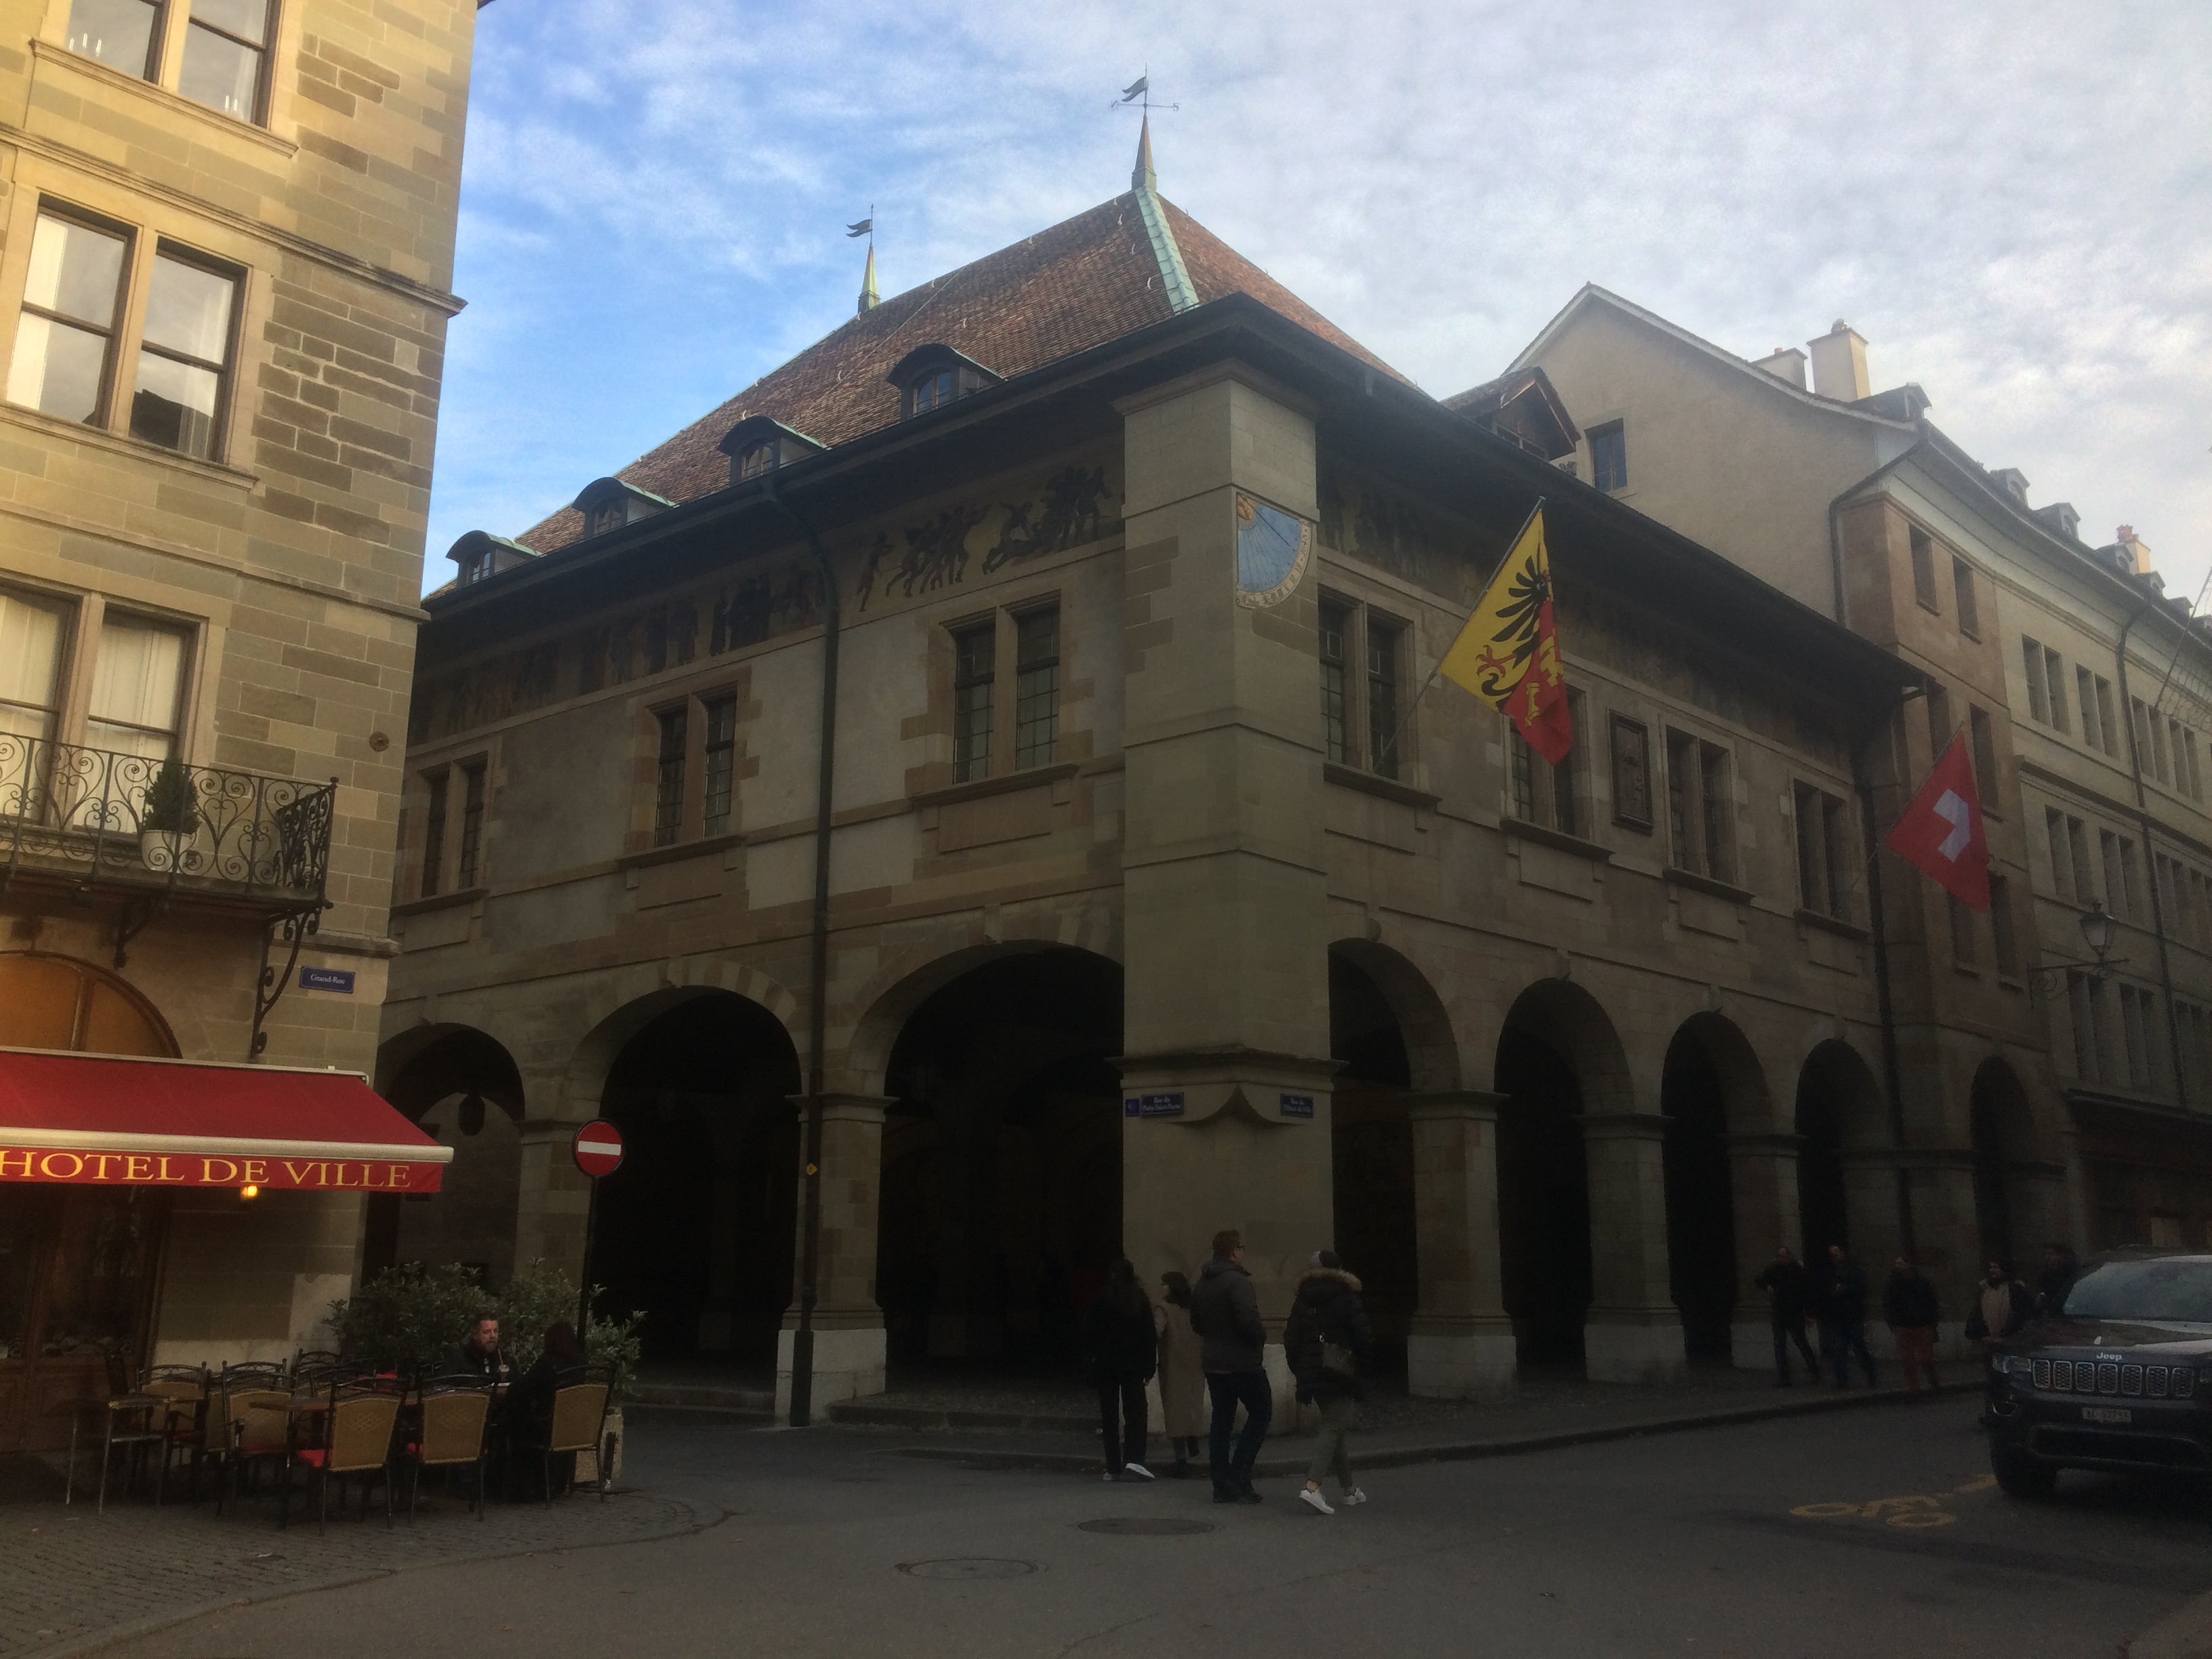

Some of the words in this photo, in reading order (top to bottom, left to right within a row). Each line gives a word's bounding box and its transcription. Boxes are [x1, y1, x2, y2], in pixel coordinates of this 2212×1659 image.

[310, 974, 345, 985] Grand-Rue
[0, 1150, 184, 1181] HOTEL
[199, 1158, 269, 1183] DE
[281, 1161, 411, 1187] VILLE
[2096, 1352, 2123, 1361] Jeep
